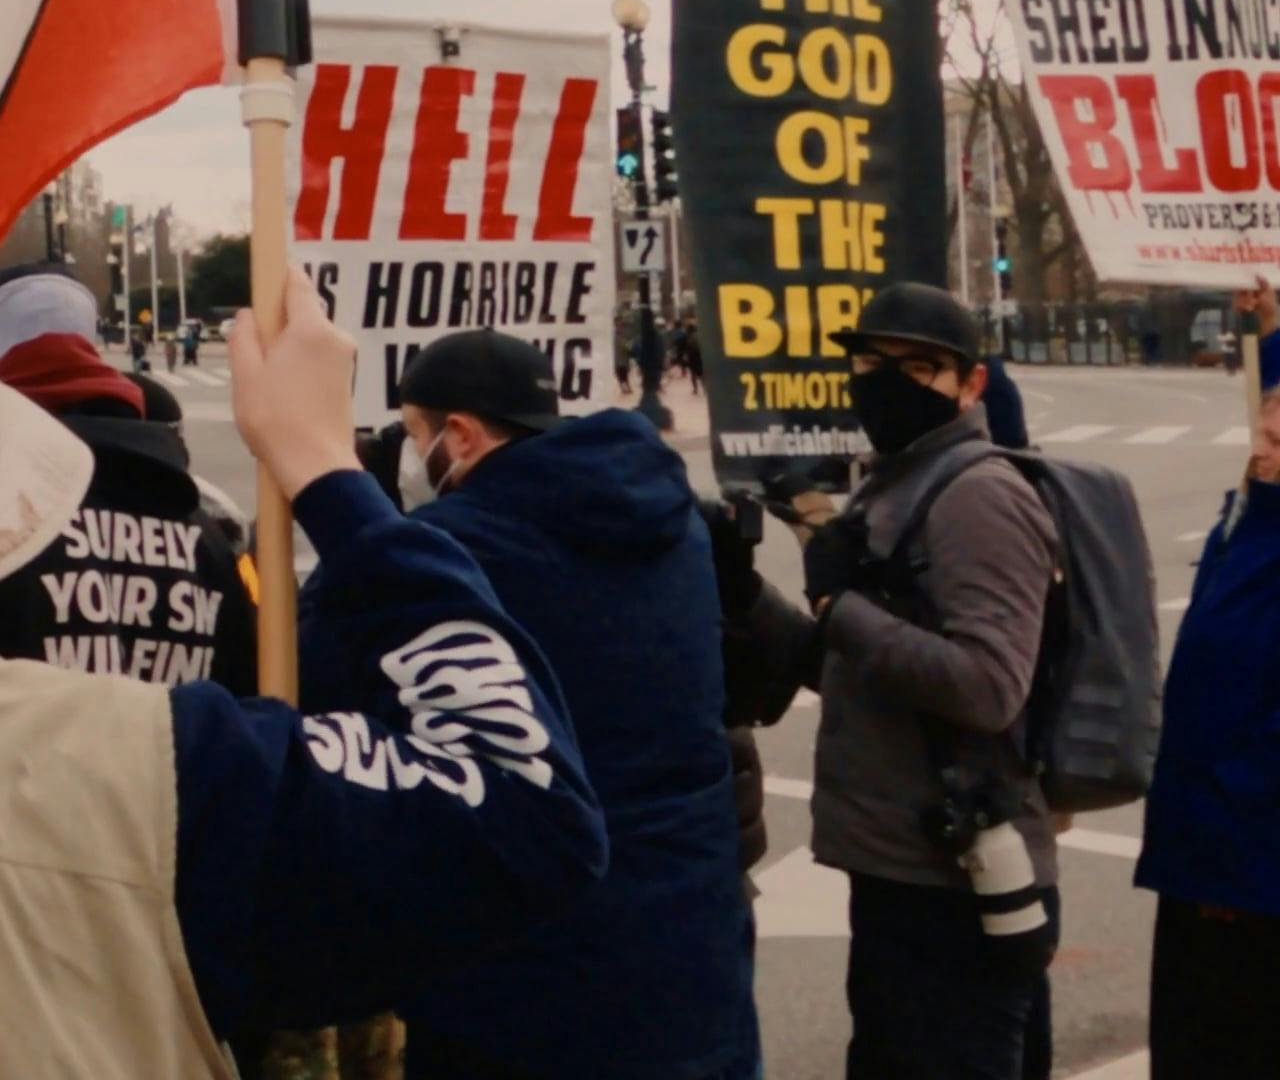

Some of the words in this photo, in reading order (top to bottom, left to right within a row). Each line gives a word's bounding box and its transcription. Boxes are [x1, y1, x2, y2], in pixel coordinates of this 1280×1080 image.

[727, 23, 893, 106] GOD
[293, 63, 598, 242] HELL
[775, 110, 871, 186] OF
[755, 197, 886, 274] THE
[362, 261, 596, 328] HORRIBLE
[718, 283, 874, 358] BIB
[740, 373, 758, 410] 2
[760, 373, 852, 409] TIMOT
[60, 509, 202, 572] SURELY
[41, 569, 157, 627] YOUR
